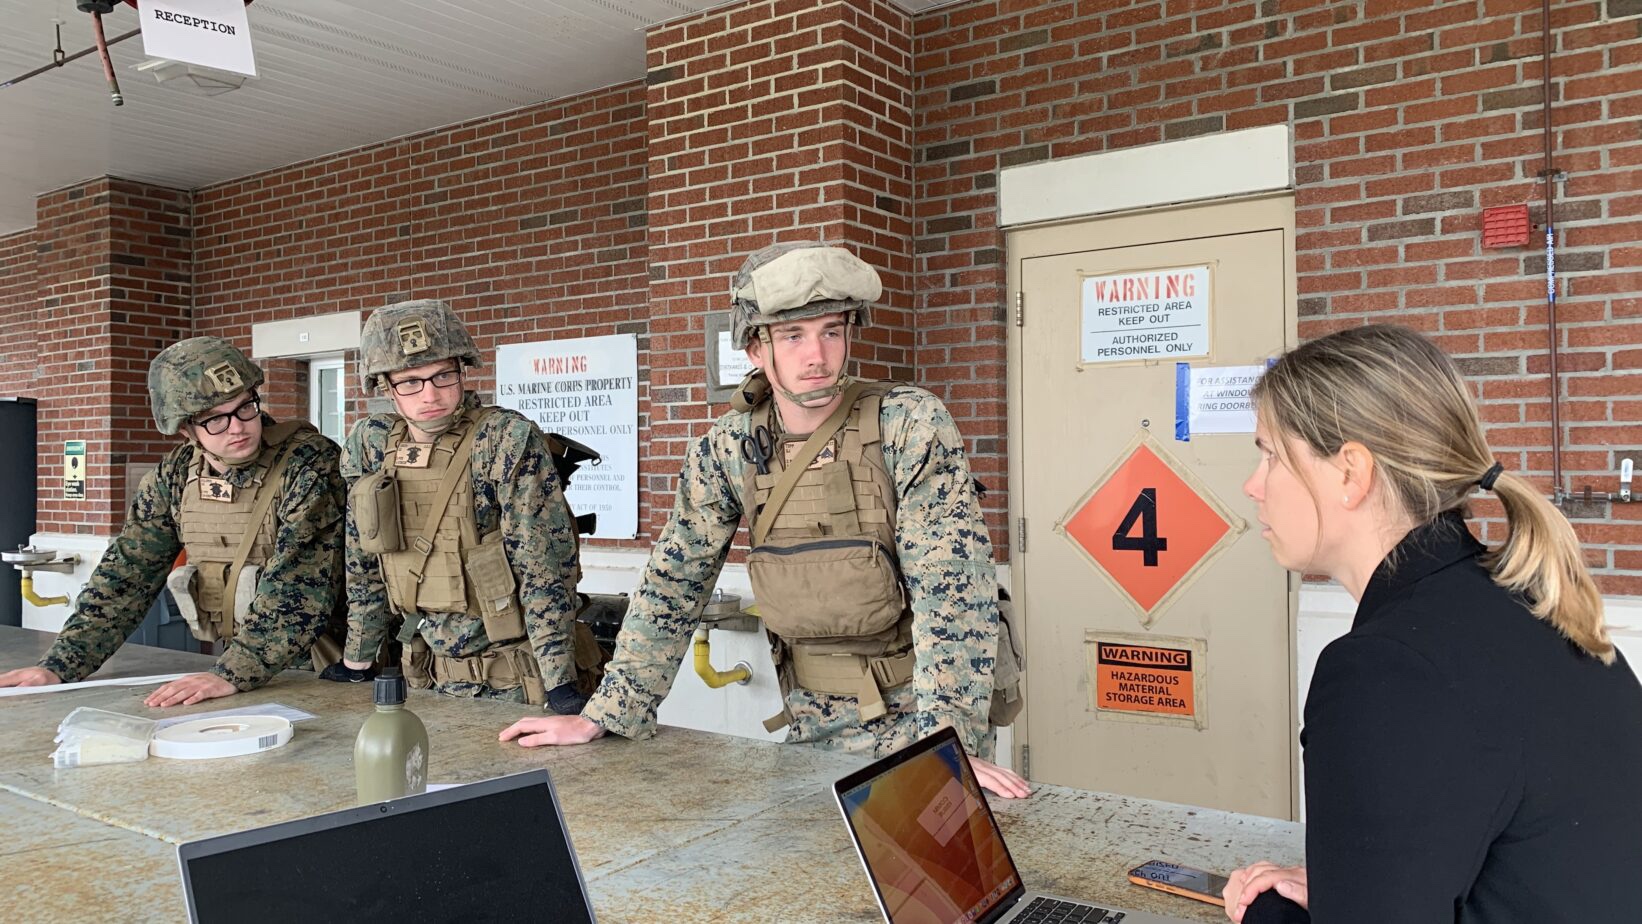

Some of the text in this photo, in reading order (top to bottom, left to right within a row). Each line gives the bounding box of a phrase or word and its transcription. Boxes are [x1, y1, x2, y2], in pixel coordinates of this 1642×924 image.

[154, 9, 236, 36] RECEPTION
[1095, 274, 1195, 303] WARNING
[1098, 301, 1193, 316] RESTRICTED AREA
[1118, 313, 1171, 326] KEEP OUT
[1112, 332, 1178, 345] AUTHORIZED
[1097, 343, 1194, 357] PERSONNEL ONLY
[533, 355, 588, 375] WARNING
[500, 376, 633, 396] U.S. MARINE CORPS PROPERTY
[1214, 376, 1261, 385] ASSISTAN
[518, 394, 613, 410] RESTRICTED AREA
[539, 410, 590, 423] KEEP OUT
[556, 425, 608, 436] PERSONNEL
[609, 424, 633, 435] ONLY
[1112, 487, 1168, 567] 4
[1103, 647, 1186, 664] WARNING
[1111, 671, 1179, 685] HAZARDOUS
[1119, 682, 1172, 696] MATERIAL
[1105, 692, 1187, 708] STORAGE AREA
